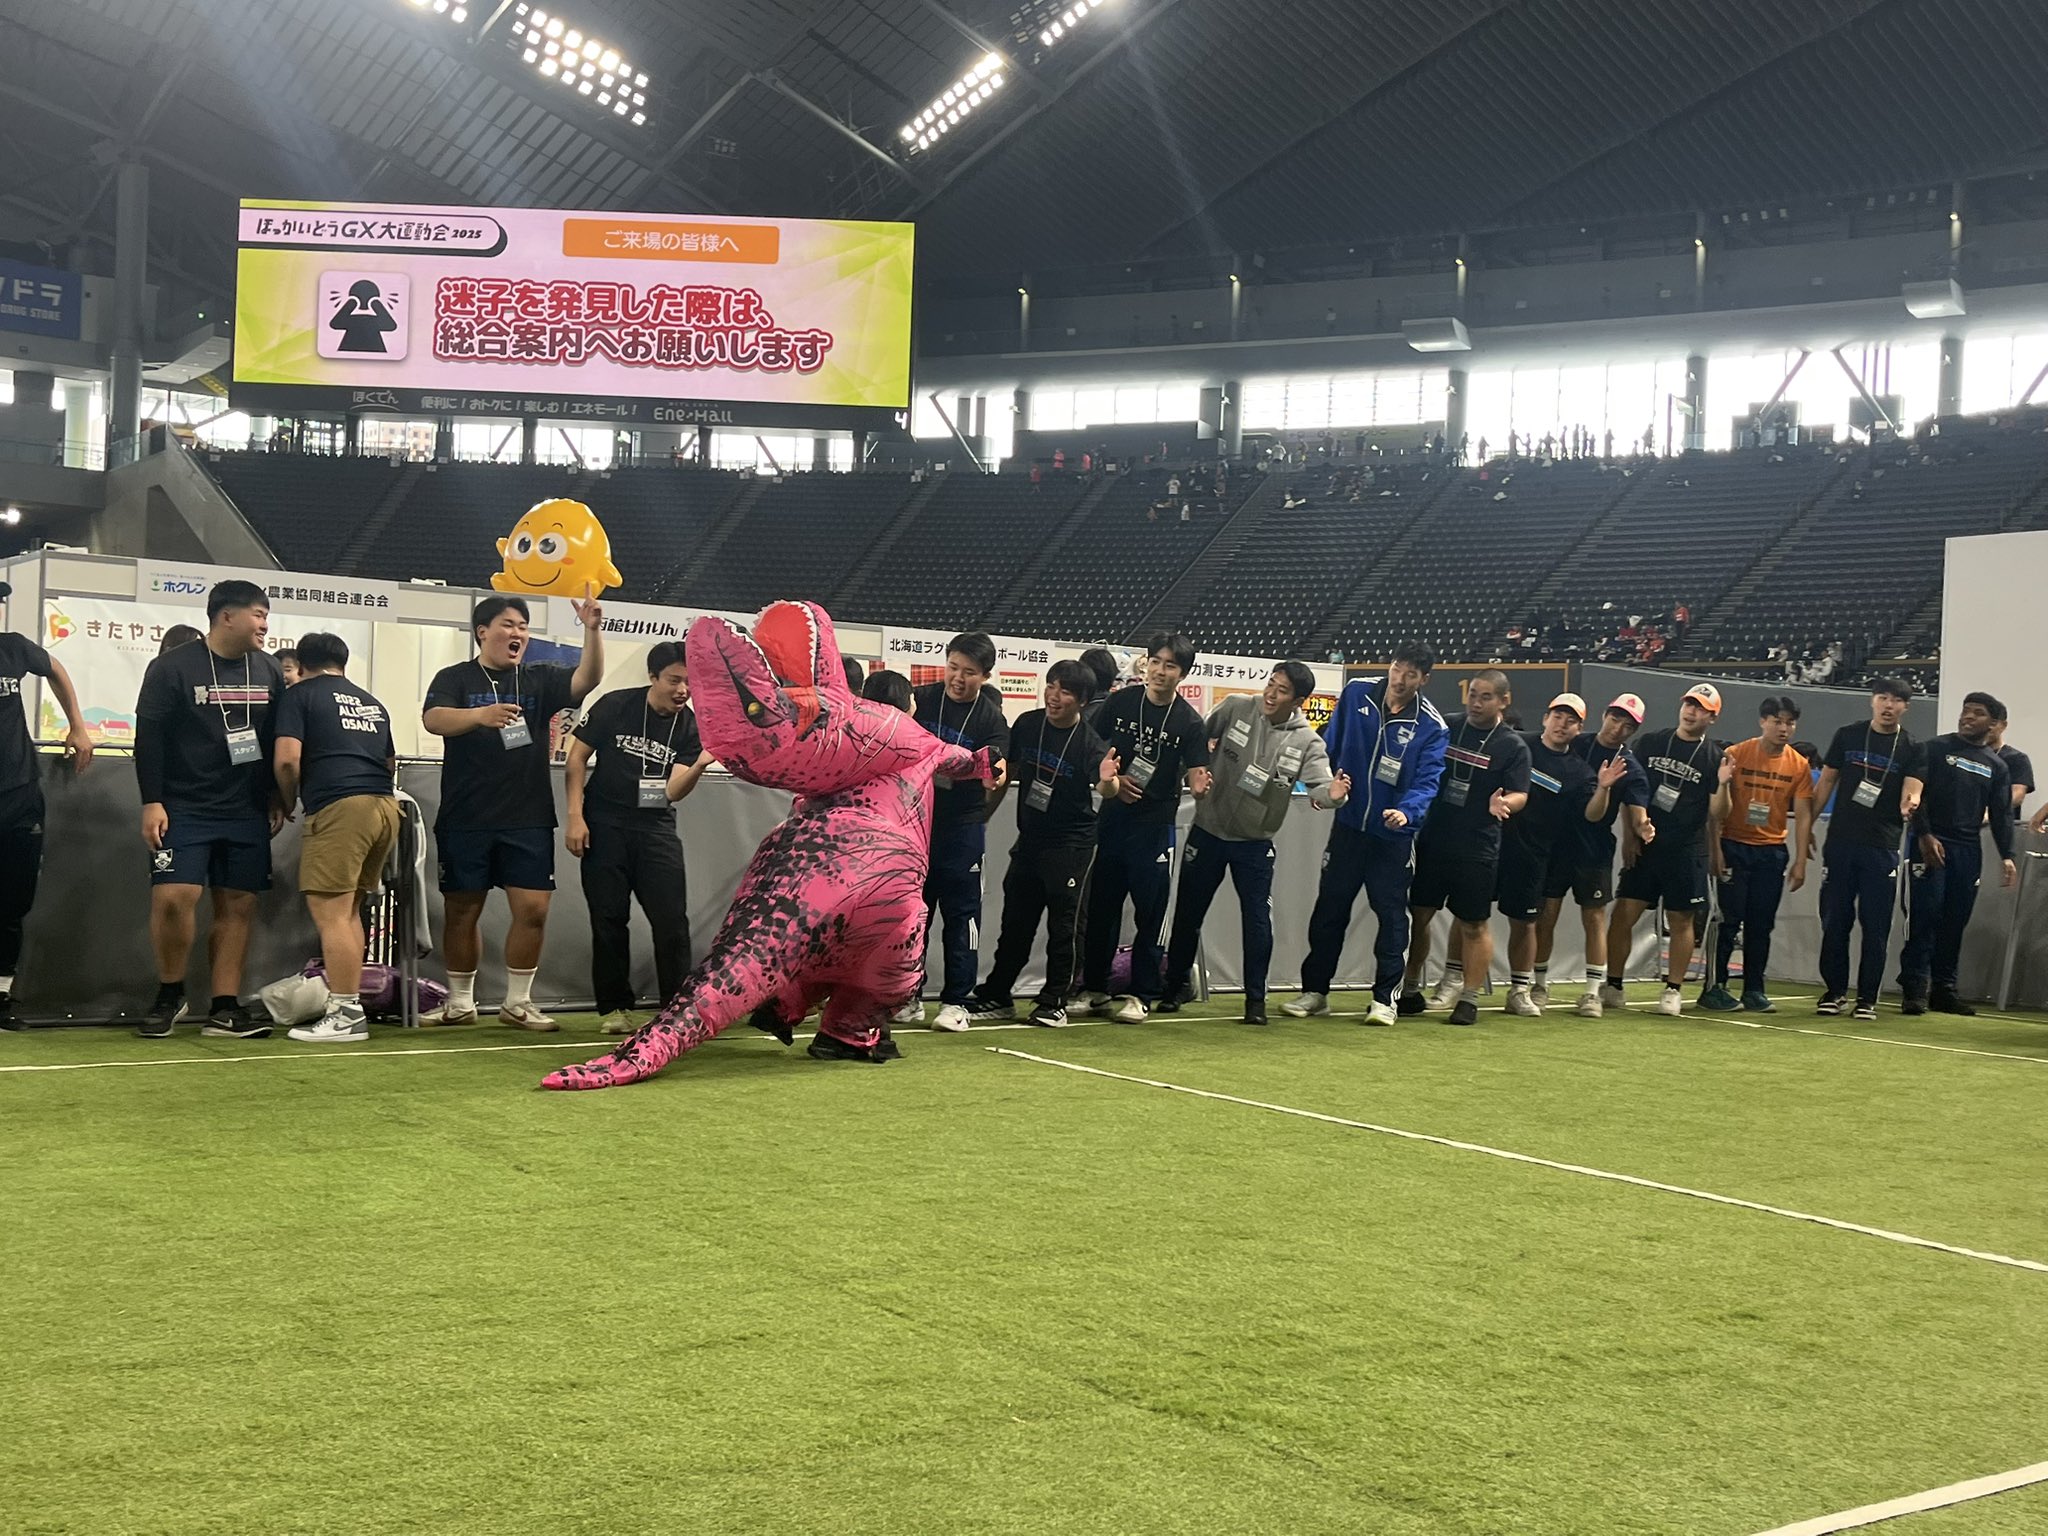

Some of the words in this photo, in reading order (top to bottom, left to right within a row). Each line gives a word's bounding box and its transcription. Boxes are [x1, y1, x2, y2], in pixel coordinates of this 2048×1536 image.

[256, 218, 450, 242] ほっかいどうGX大運動会
[451, 229, 483, 240] 2025
[603, 229, 740, 252] ご来場の皆様へ
[0, 276, 62, 305] ドラ
[437, 278, 774, 328] 迷子を発見した際は、
[436, 320, 831, 368] 総合案内へお願いします
[353, 390, 398, 404] ほくでん
[163, 580, 206, 595] ホクレン
[262, 585, 390, 608] 農業協同組合連合会
[333, 692, 363, 707] 2022
[339, 705, 360, 718] ALL
[341, 718, 378, 734] OSAKA
[1116, 717, 1181, 744] TENRI
[233, 745, 256, 756] スタッフ
